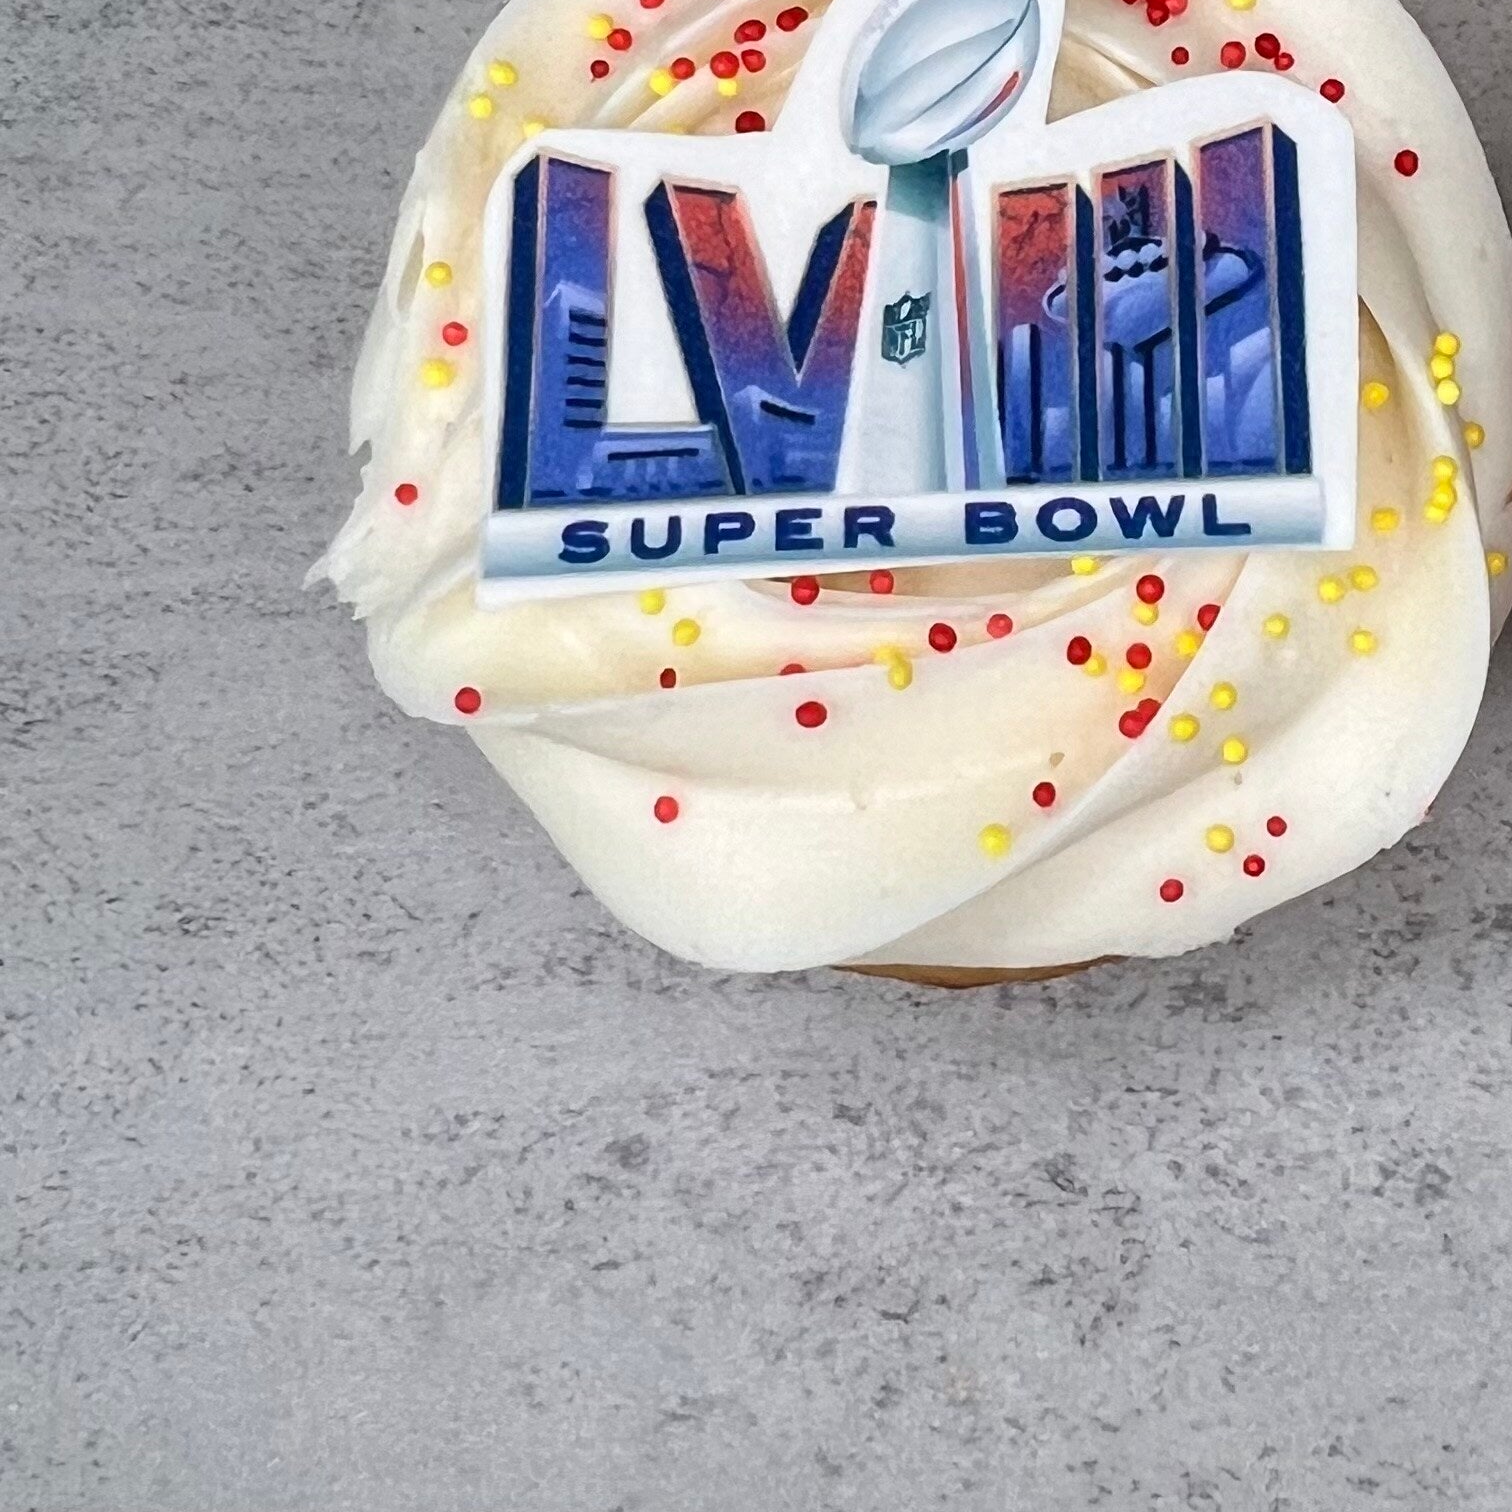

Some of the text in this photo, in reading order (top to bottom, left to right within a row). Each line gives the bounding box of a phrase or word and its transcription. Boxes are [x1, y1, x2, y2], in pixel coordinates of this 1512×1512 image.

[496, 123, 1315, 510] LVIII
[559, 494, 1252, 565] SUPER BOWL
